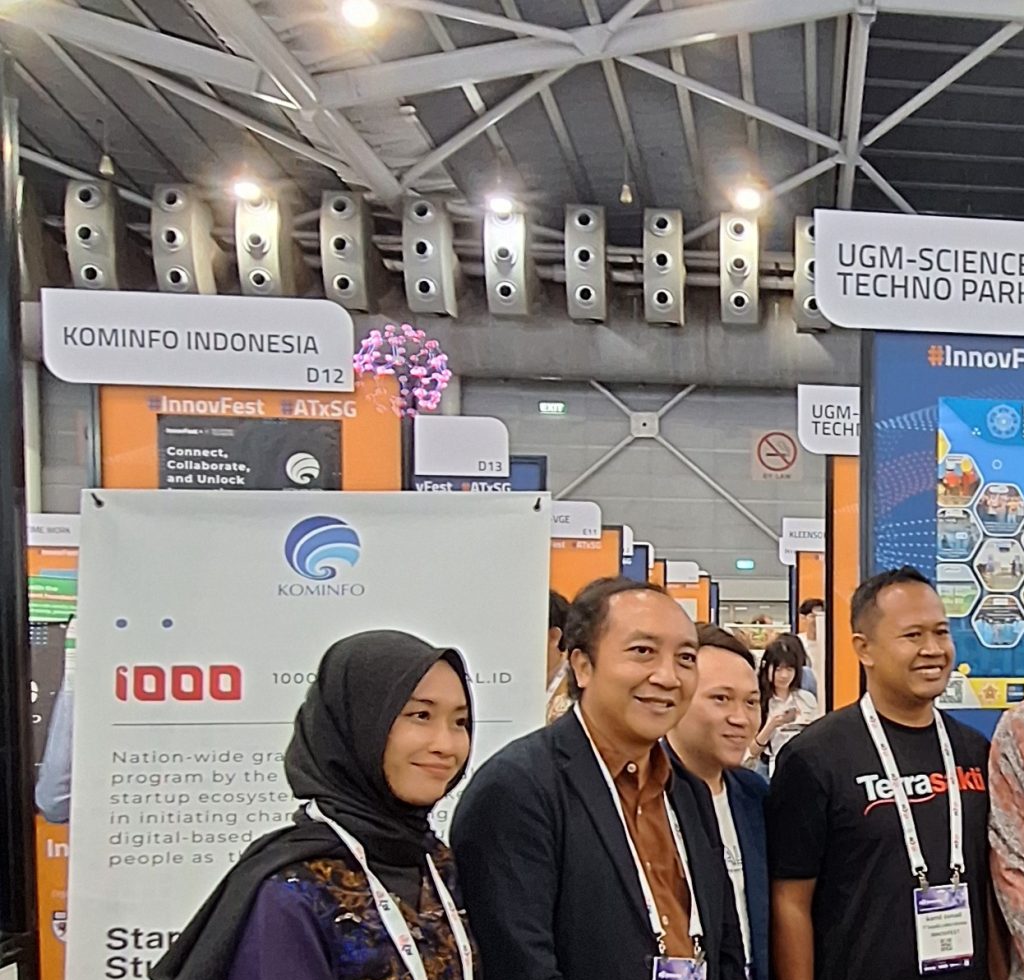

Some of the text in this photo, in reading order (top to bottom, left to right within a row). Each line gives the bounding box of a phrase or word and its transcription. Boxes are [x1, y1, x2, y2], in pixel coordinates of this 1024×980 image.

[837, 271, 952, 301] TECHNO
[63, 327, 319, 355] KOMINFO INDONESIA
[307, 367, 344, 384] D12
[812, 404, 860, 420] UGM-
[167, 447, 228, 459] Connect,
[167, 461, 250, 473] Collaborate,
[478, 461, 502, 472] D13
[167, 475, 245, 485] and Unlock
[789, 531, 826, 540] KLEENSO
[278, 583, 365, 597] KOMINFO
[112, 750, 243, 764] Nation-wide
[112, 769, 278, 787] program by the
[110, 791, 190, 807] startup
[110, 811, 130, 824] in
[139, 810, 238, 827] initiating
[109, 830, 253, 848] digital-based
[109, 850, 184, 868] people
[192, 852, 214, 864] as
